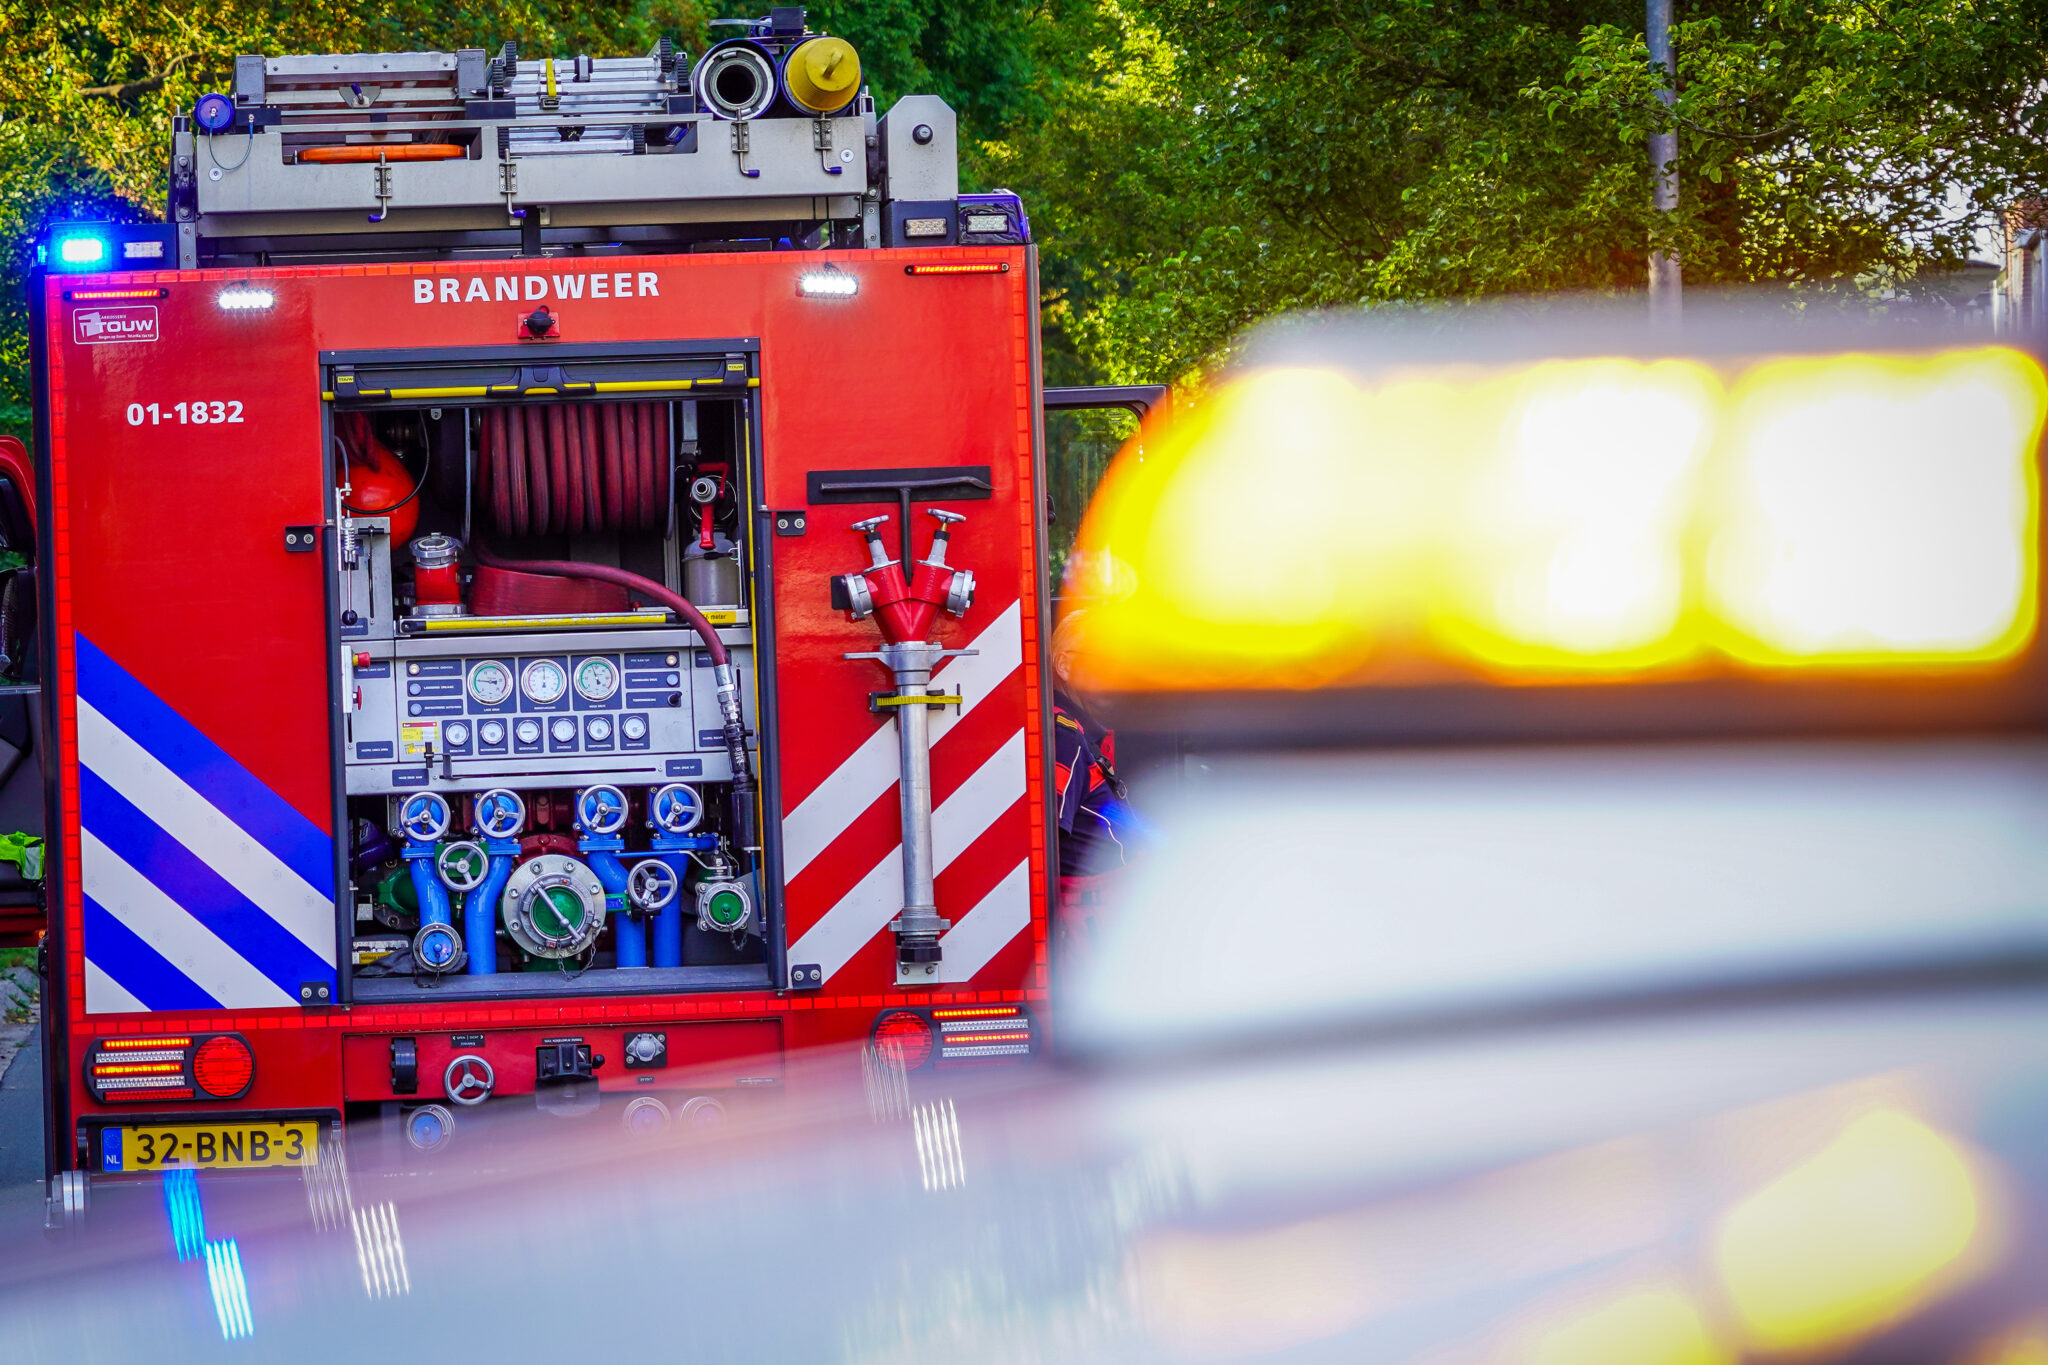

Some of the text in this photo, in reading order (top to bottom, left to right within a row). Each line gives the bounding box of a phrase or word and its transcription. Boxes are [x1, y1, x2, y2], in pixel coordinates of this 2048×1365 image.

[414, 272, 660, 304] BRANDWEER
[127, 400, 244, 426] 01-1832
[106, 1155, 120, 1165] NL
[136, 1129, 304, 1165] 32-BNB-3
